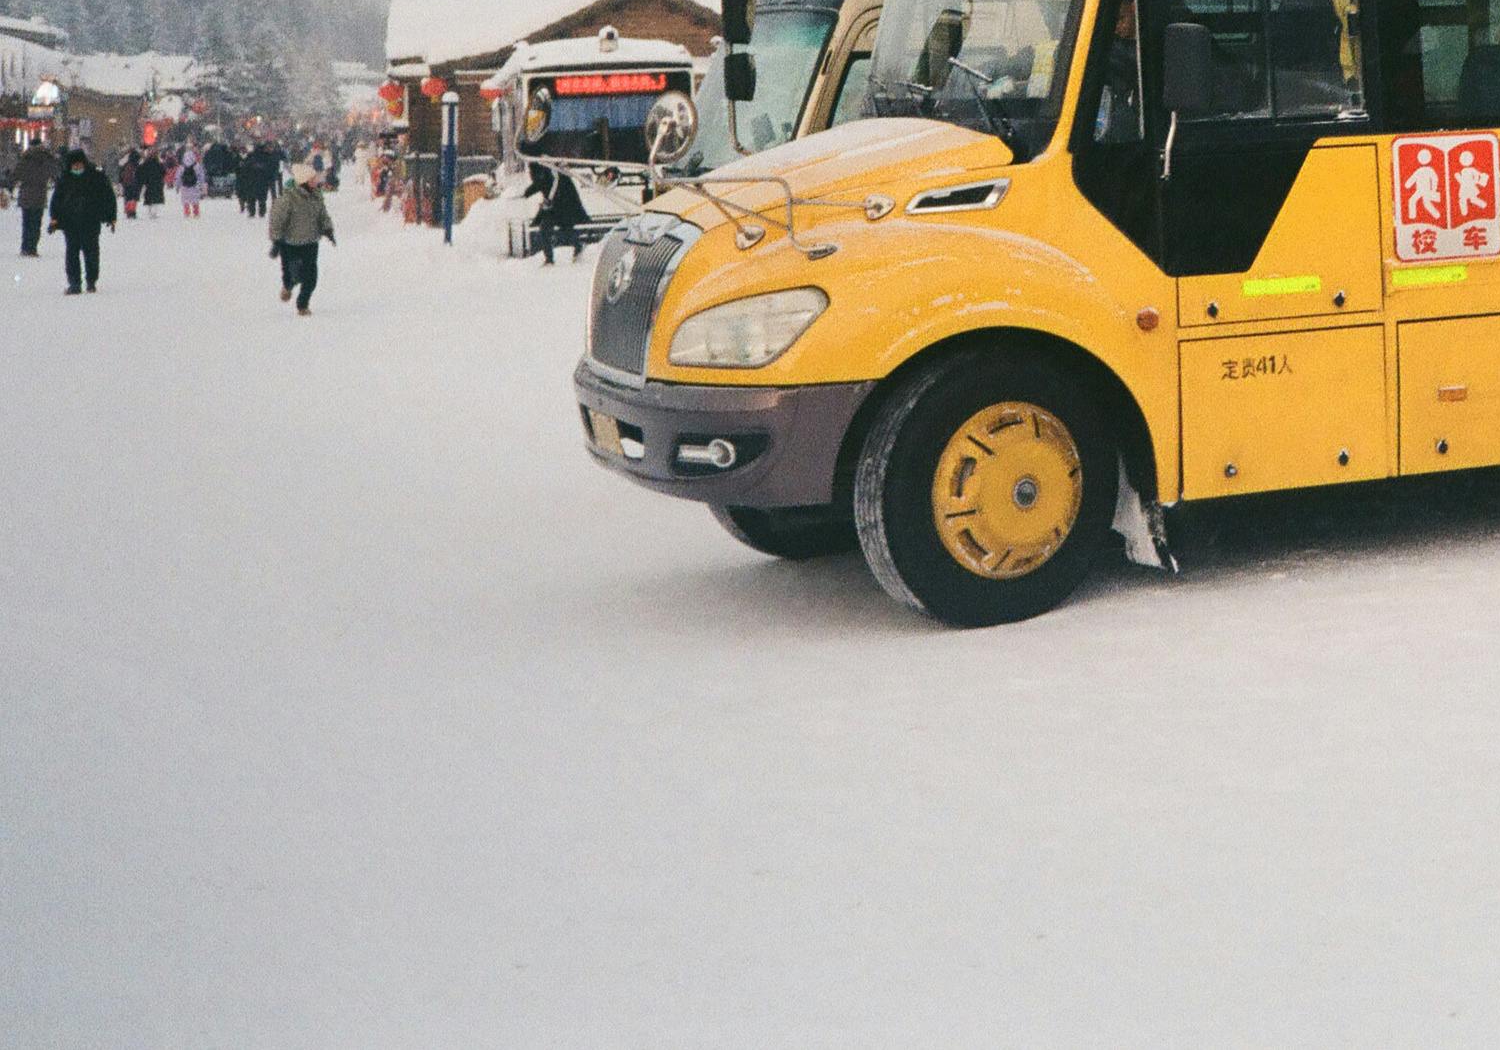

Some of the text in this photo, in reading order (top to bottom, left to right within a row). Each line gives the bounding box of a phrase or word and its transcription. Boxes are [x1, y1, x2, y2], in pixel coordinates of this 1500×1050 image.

[1412, 226, 1488, 254] 校车
[1221, 355, 1293, 380] 定员41人
